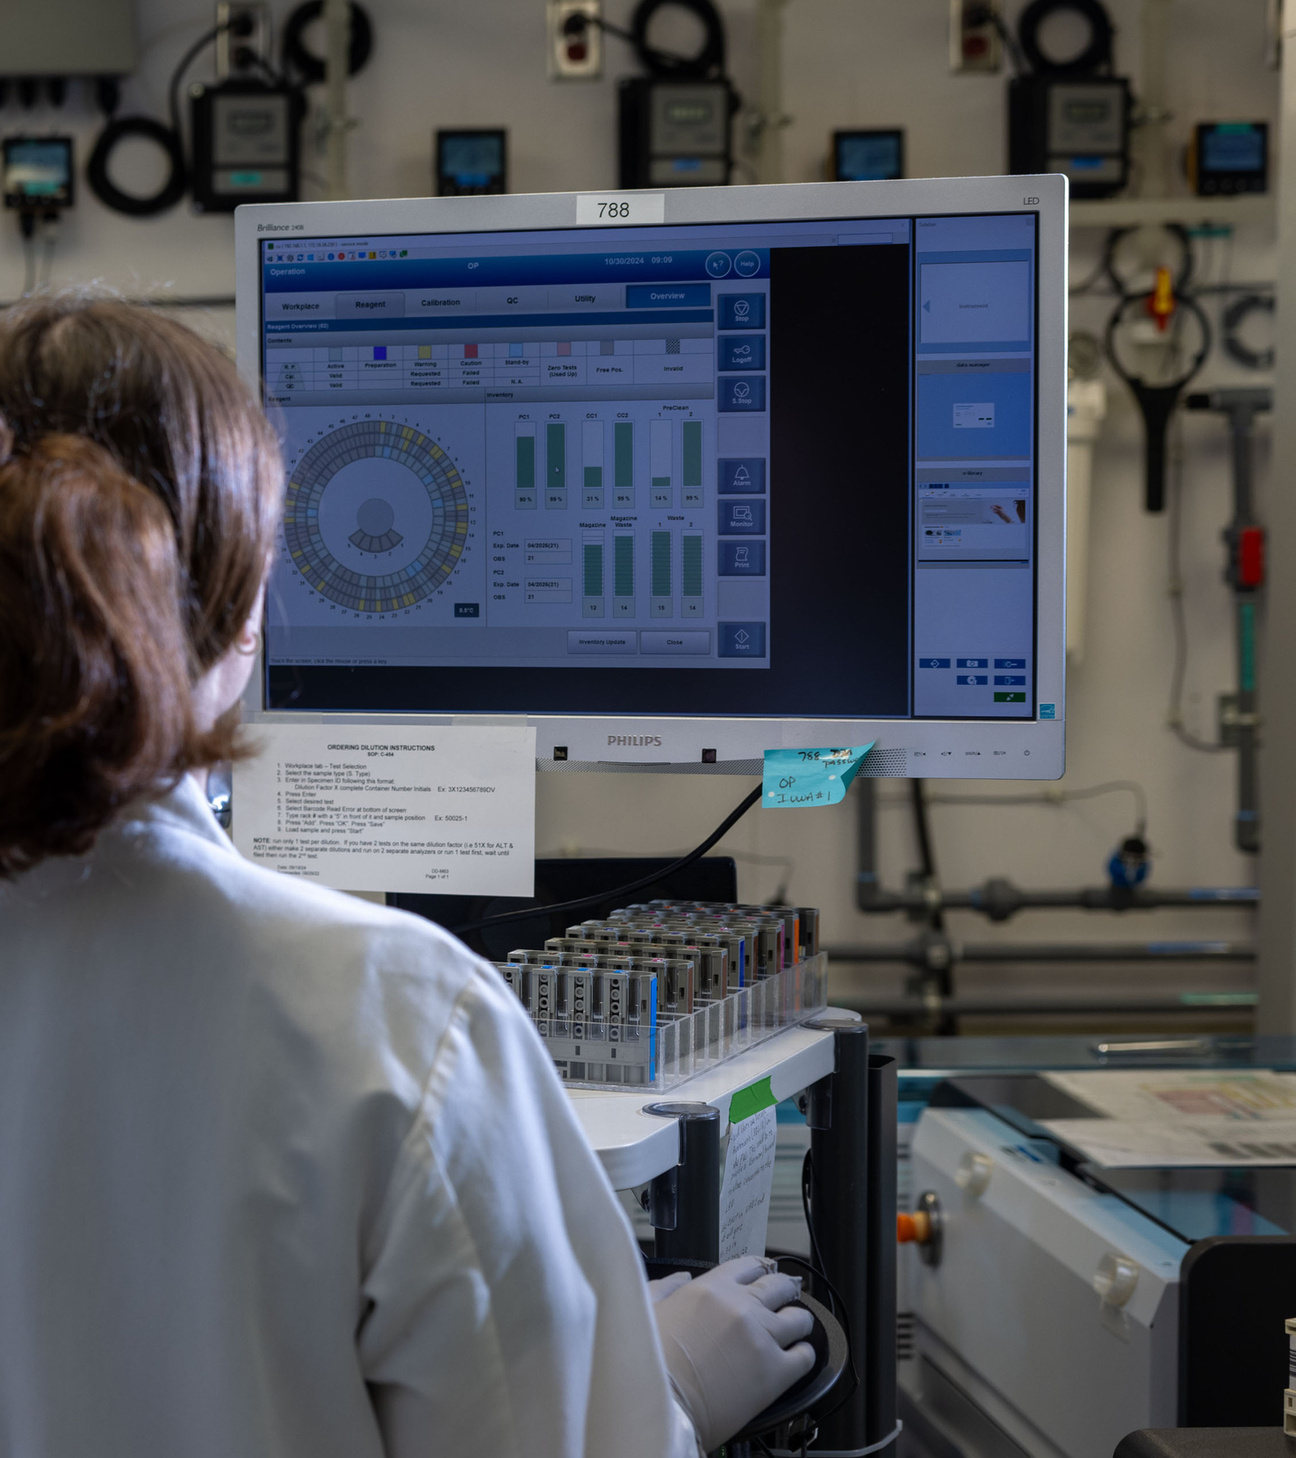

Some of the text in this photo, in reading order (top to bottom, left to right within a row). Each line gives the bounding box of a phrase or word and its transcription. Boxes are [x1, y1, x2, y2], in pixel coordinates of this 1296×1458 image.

[1023, 197, 1040, 206] LED
[598, 202, 629, 218] 788
[257, 224, 289, 232] Brilliance
[605, 257, 645, 265] 10/30/2024
[270, 268, 305, 277] Operation
[421, 299, 460, 307] Calibration
[507, 297, 518, 305] QC
[575, 295, 596, 304] Utility
[282, 303, 319, 311] Workplace
[355, 301, 386, 310] Reagent
[267, 323, 290, 331] Reagent
[608, 735, 662, 747] PHILIPS
[798, 751, 821, 761] 788
[779, 776, 796, 789] OP
[410, 848, 436, 856] analyzers
